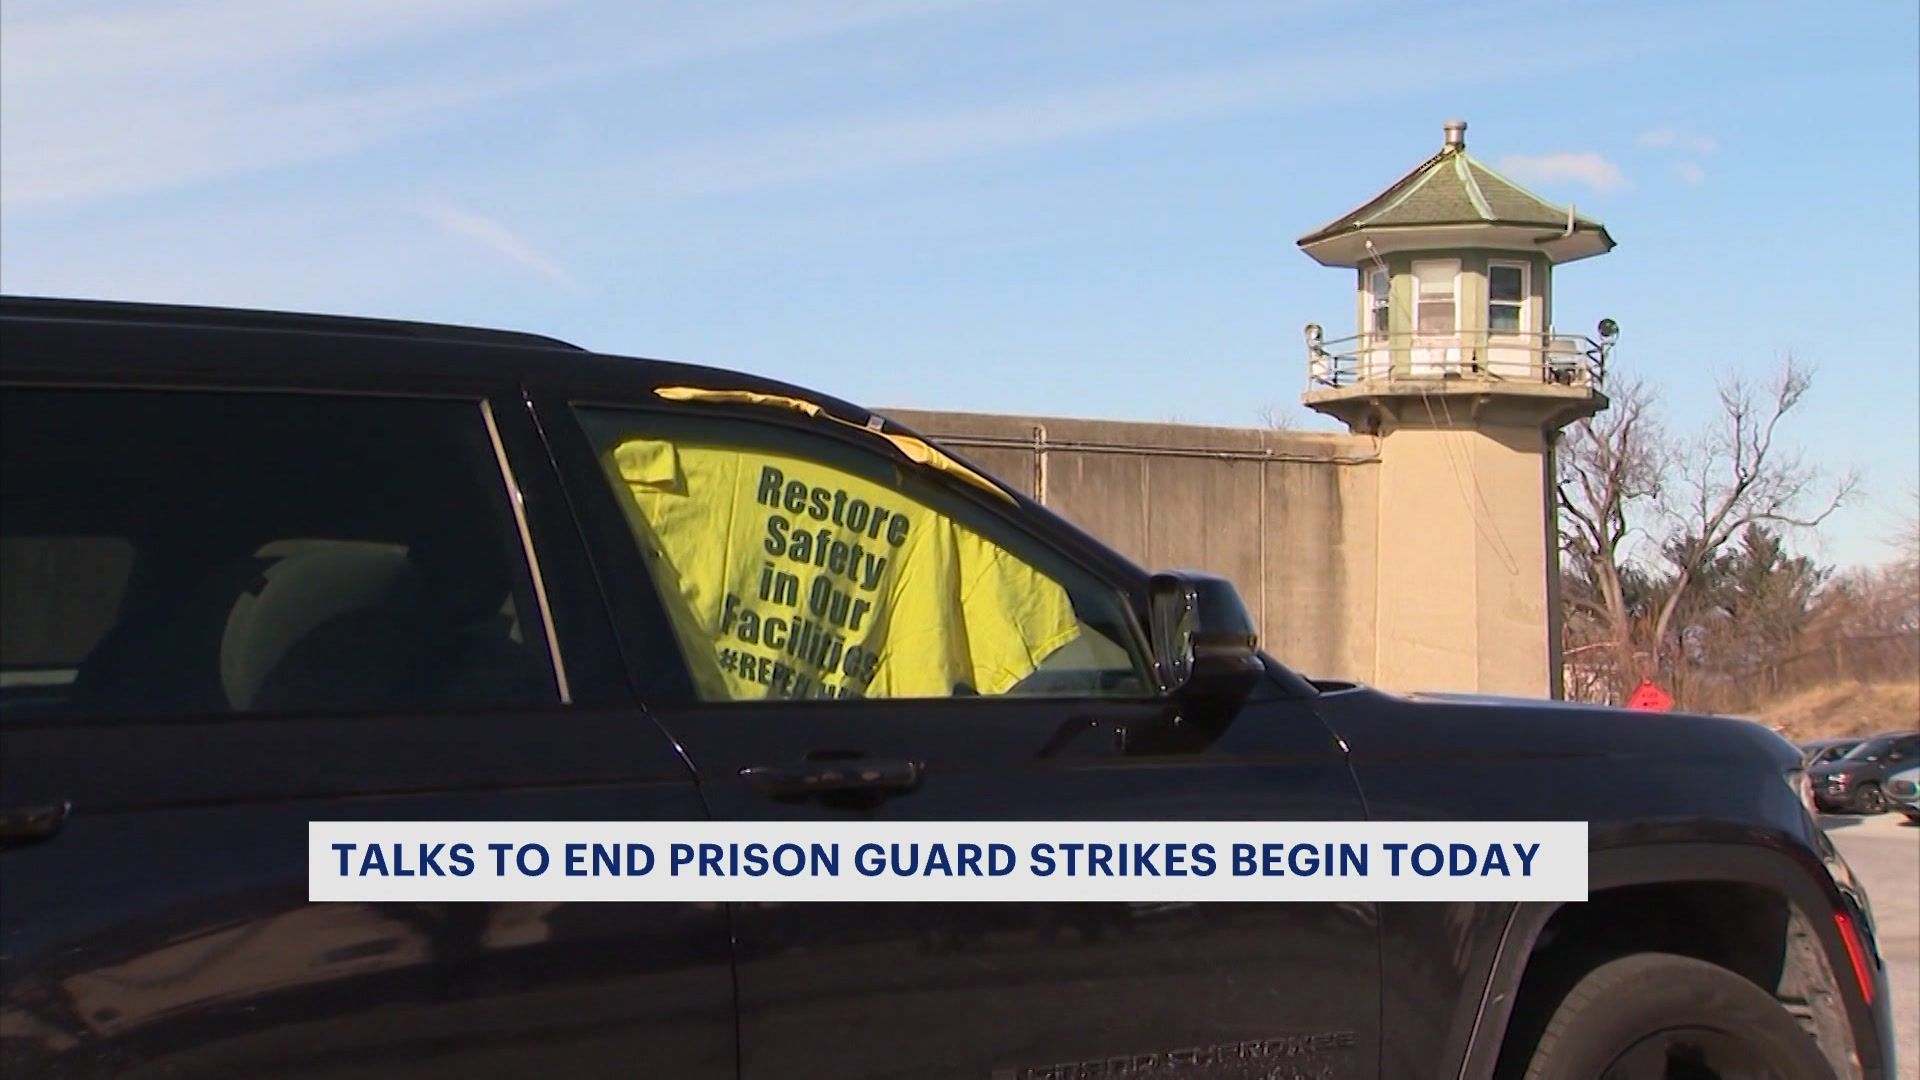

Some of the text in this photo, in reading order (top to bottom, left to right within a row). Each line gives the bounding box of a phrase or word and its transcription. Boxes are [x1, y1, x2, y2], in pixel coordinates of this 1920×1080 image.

[757, 465, 910, 548] Restore
[764, 515, 887, 592] Safety
[758, 561, 871, 632] in Our
[720, 593, 879, 682] Facilities
